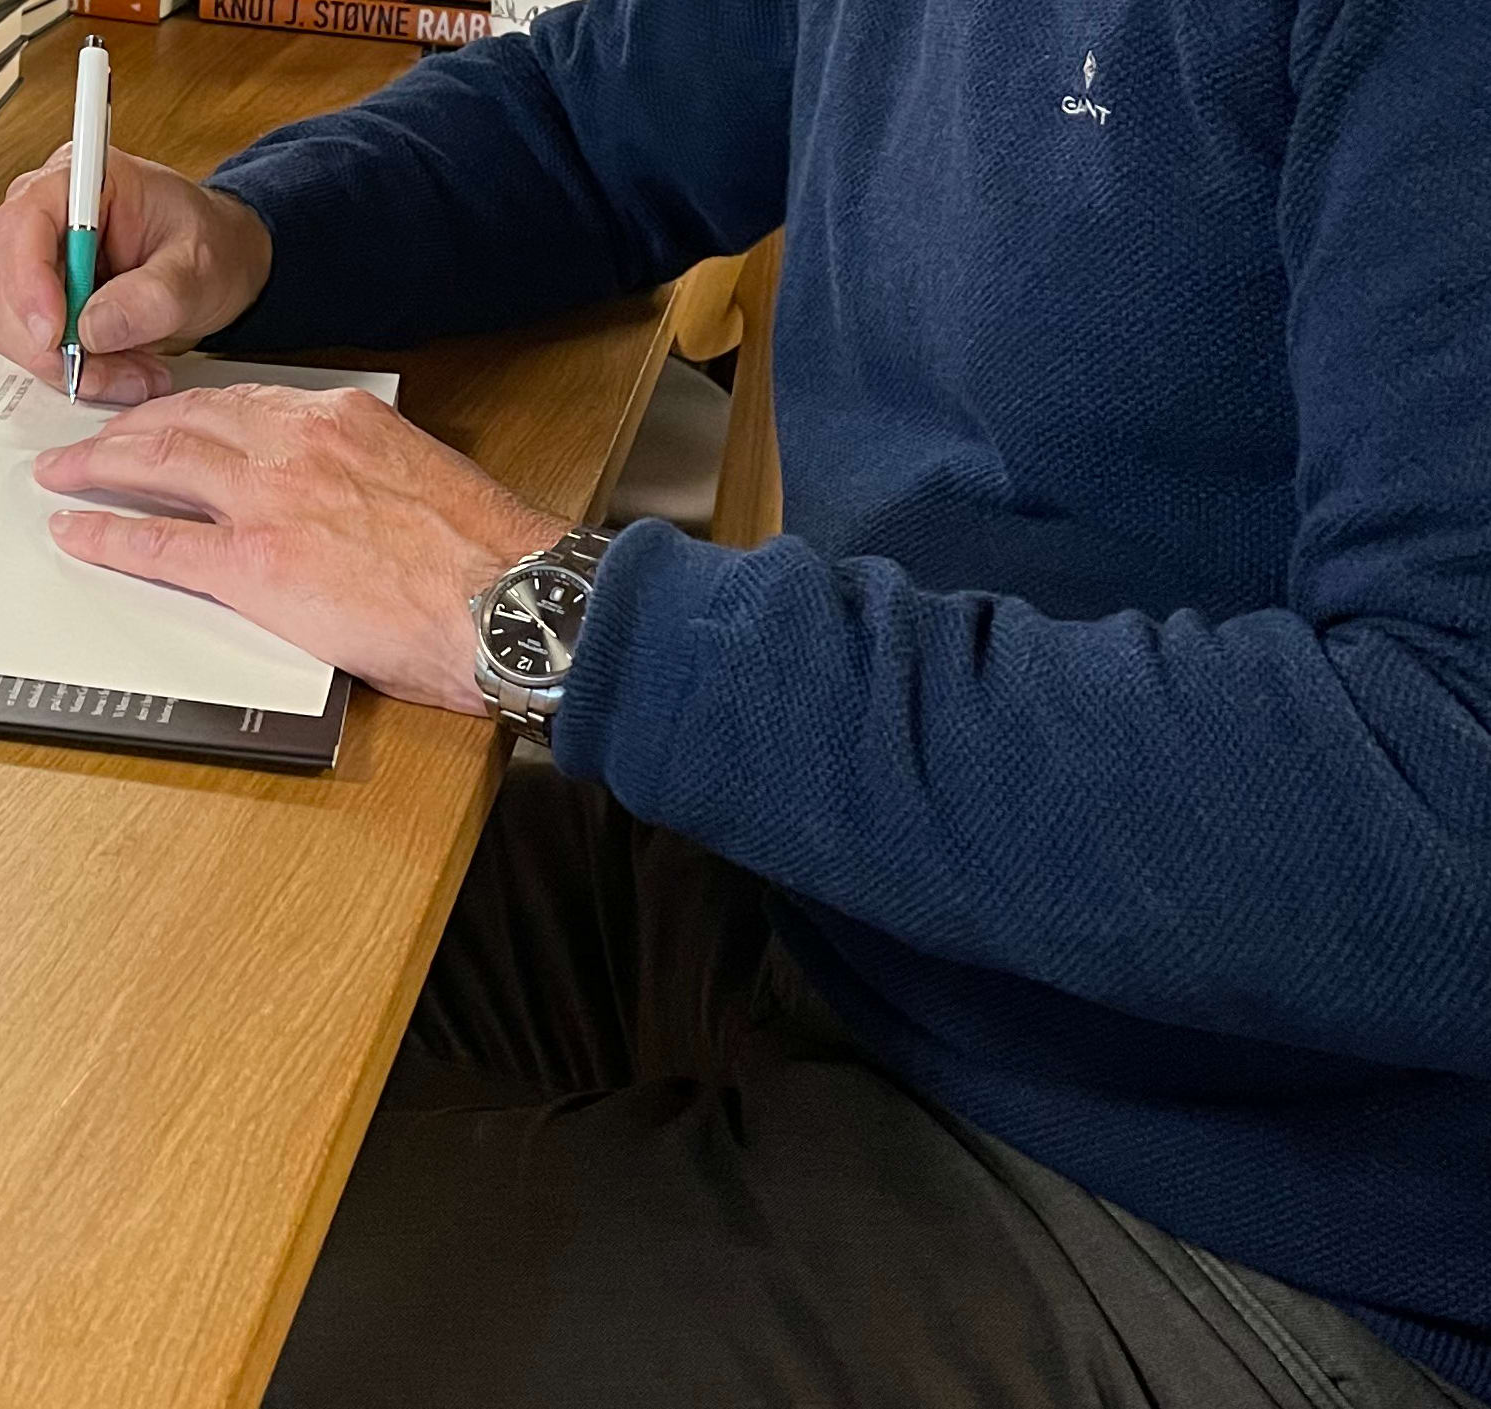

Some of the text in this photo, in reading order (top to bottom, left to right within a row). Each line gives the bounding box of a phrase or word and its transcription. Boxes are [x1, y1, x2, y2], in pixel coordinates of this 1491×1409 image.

[314, 0, 409, 36] STØVNE
[417, 9, 493, 42] RAAB
[517, 656, 533, 671] 12
